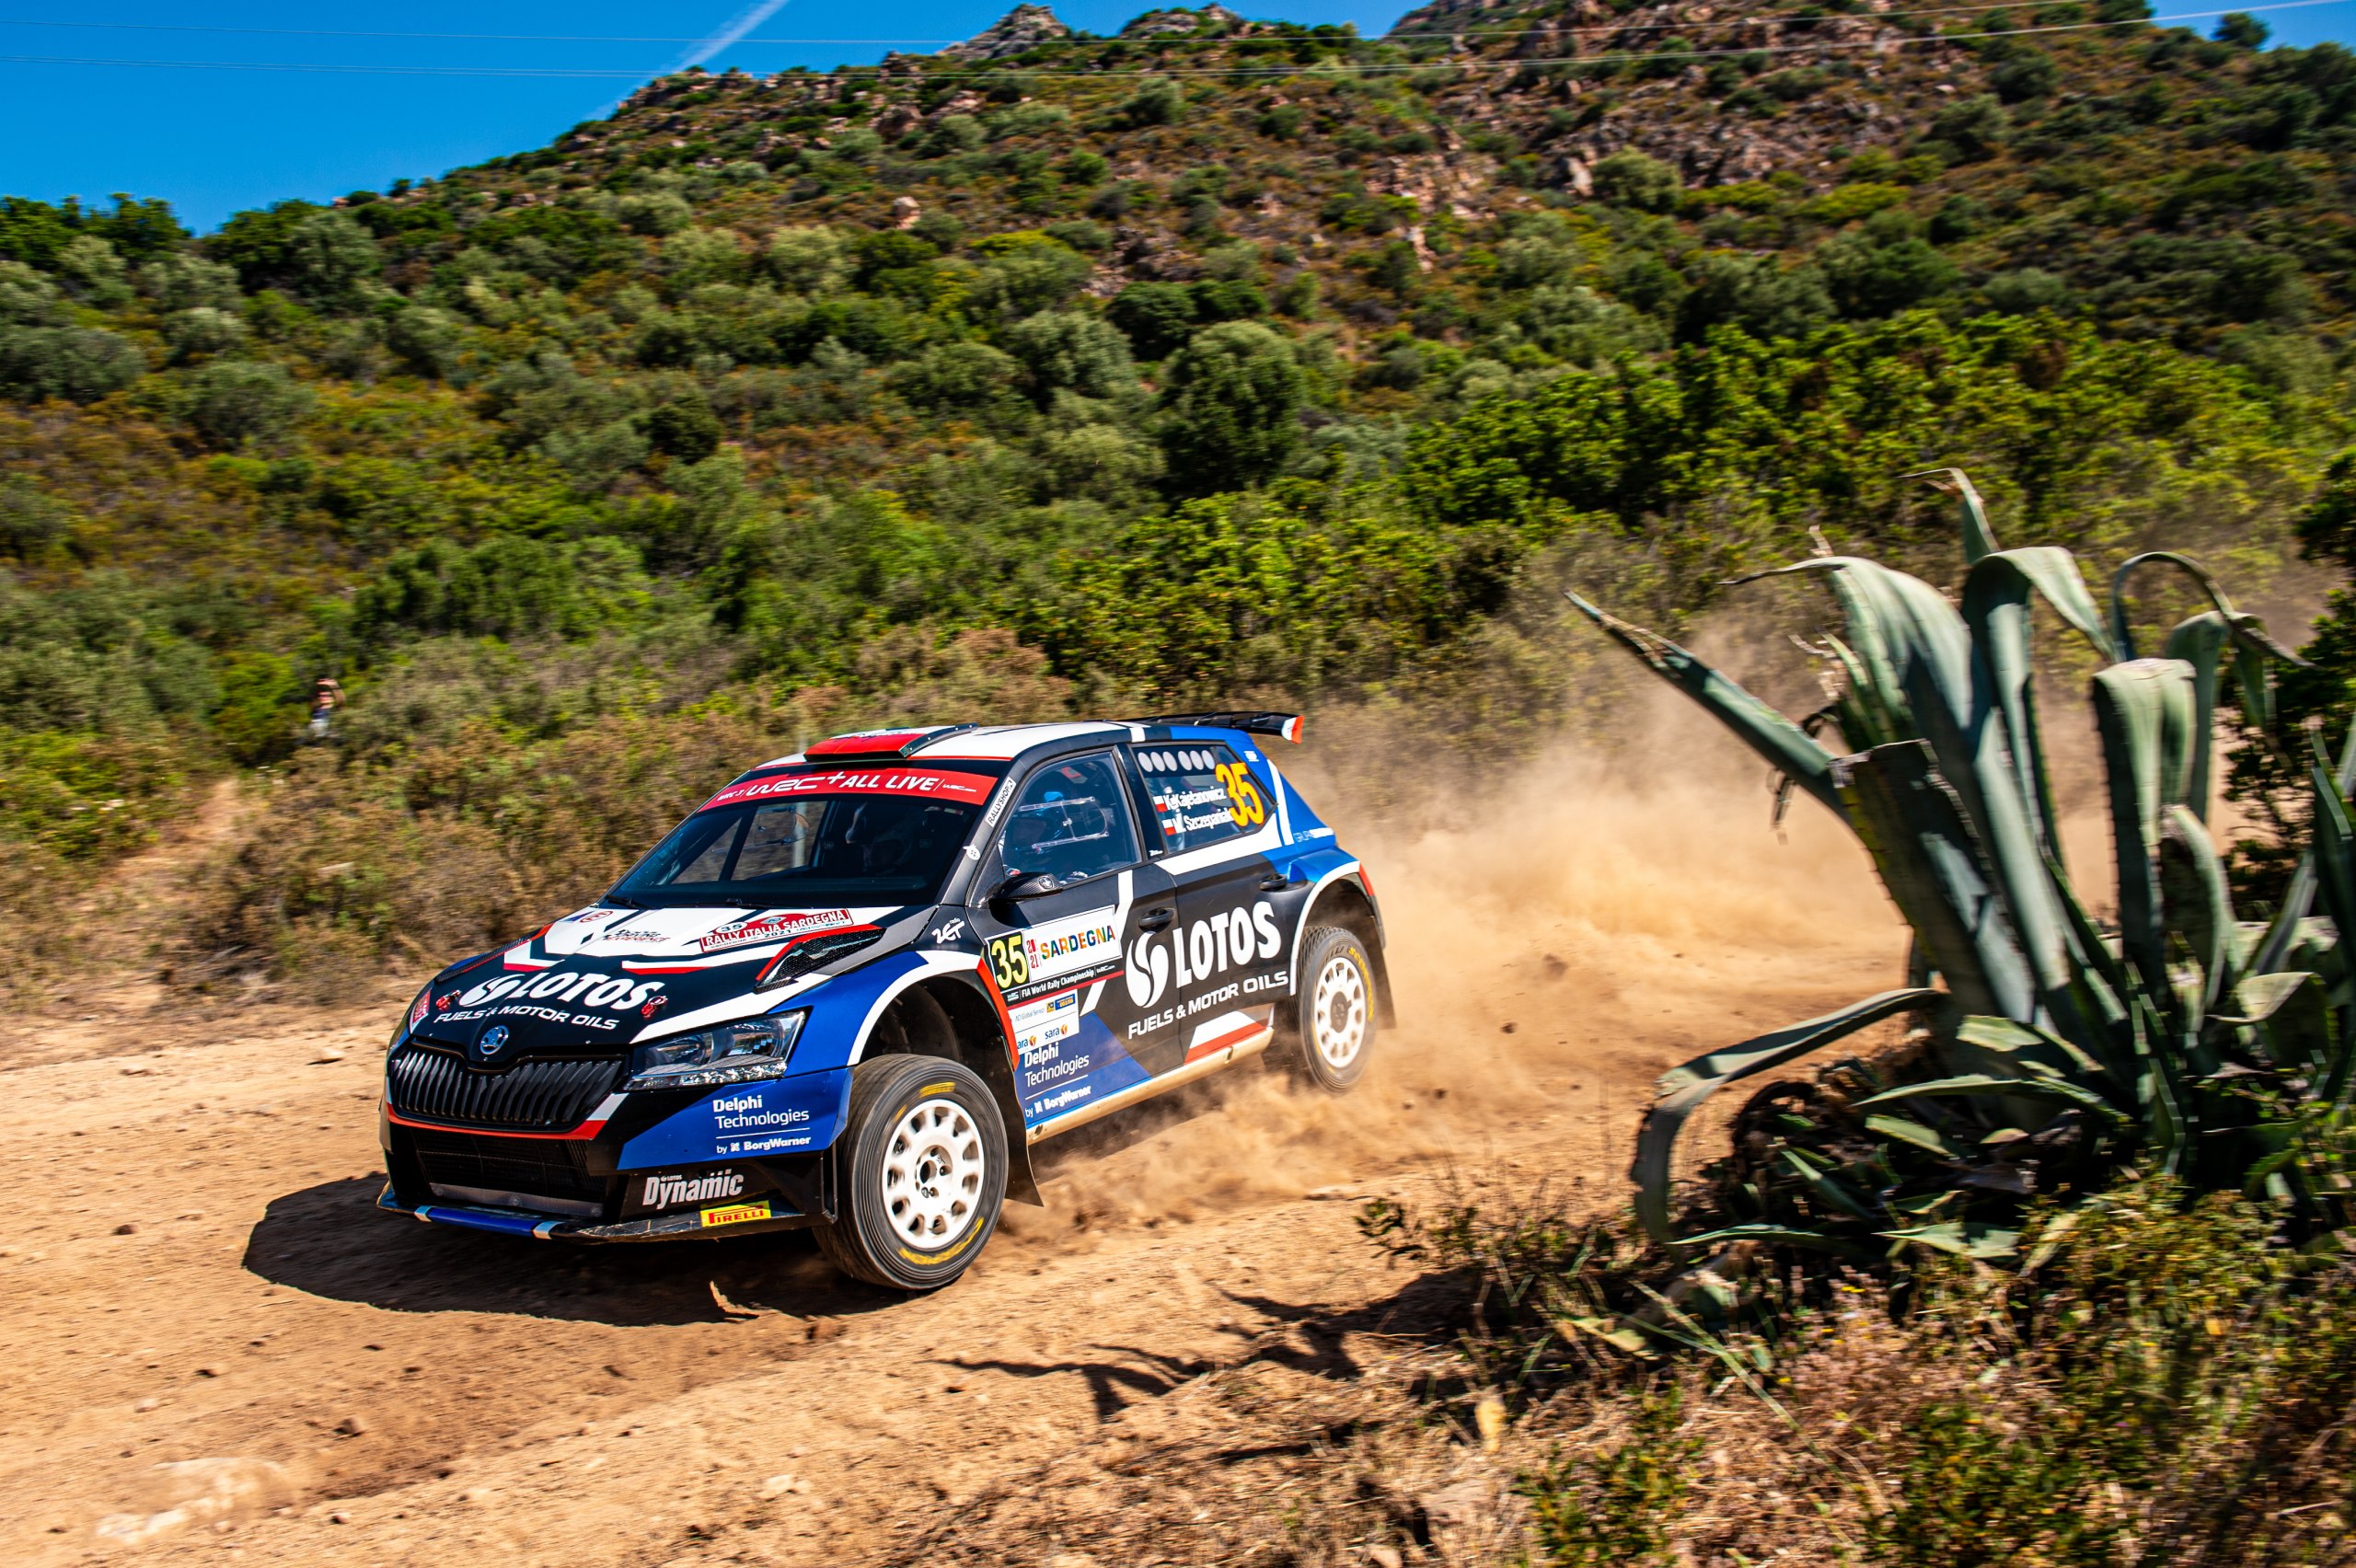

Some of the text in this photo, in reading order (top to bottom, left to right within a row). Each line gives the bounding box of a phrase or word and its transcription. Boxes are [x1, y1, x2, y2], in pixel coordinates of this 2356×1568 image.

[838, 775, 881, 788] ALL
[884, 775, 939, 791] LIVE
[1215, 762, 1265, 826] 35
[706, 930, 741, 946] RALLY
[743, 923, 780, 939] ITALIA
[782, 911, 846, 930] SARDEGNA
[721, 923, 742, 932] 35
[764, 929, 791, 938] 2021
[1040, 925, 1115, 960] SARDEGNA
[1172, 901, 1282, 989] LOTOS
[990, 935, 1028, 989] 35
[504, 972, 665, 1009] LOTOS
[1021, 989, 1031, 998] FIA
[1031, 983, 1046, 996] World
[1046, 979, 1060, 990] Rally
[1060, 969, 1094, 986] Championship
[433, 1009, 482, 1023] FUELS
[501, 1006, 569, 1022] MOTOR
[570, 1014, 620, 1031] OILS
[1128, 971, 1288, 1039] FUELS & MOTOR OILS
[1017, 1038, 1029, 1049] ara
[1045, 1028, 1060, 1040] sara
[1024, 1042, 1058, 1067] Delphi
[1025, 1055, 1090, 1087] Technologies
[712, 1095, 762, 1113] Delphi
[1025, 1086, 1091, 1118] by BorgWarner
[714, 1109, 810, 1129] Technologies
[716, 1136, 811, 1155] by BorgWarner
[642, 1169, 745, 1209] Dynamic
[709, 1205, 764, 1225] PIRELLI
